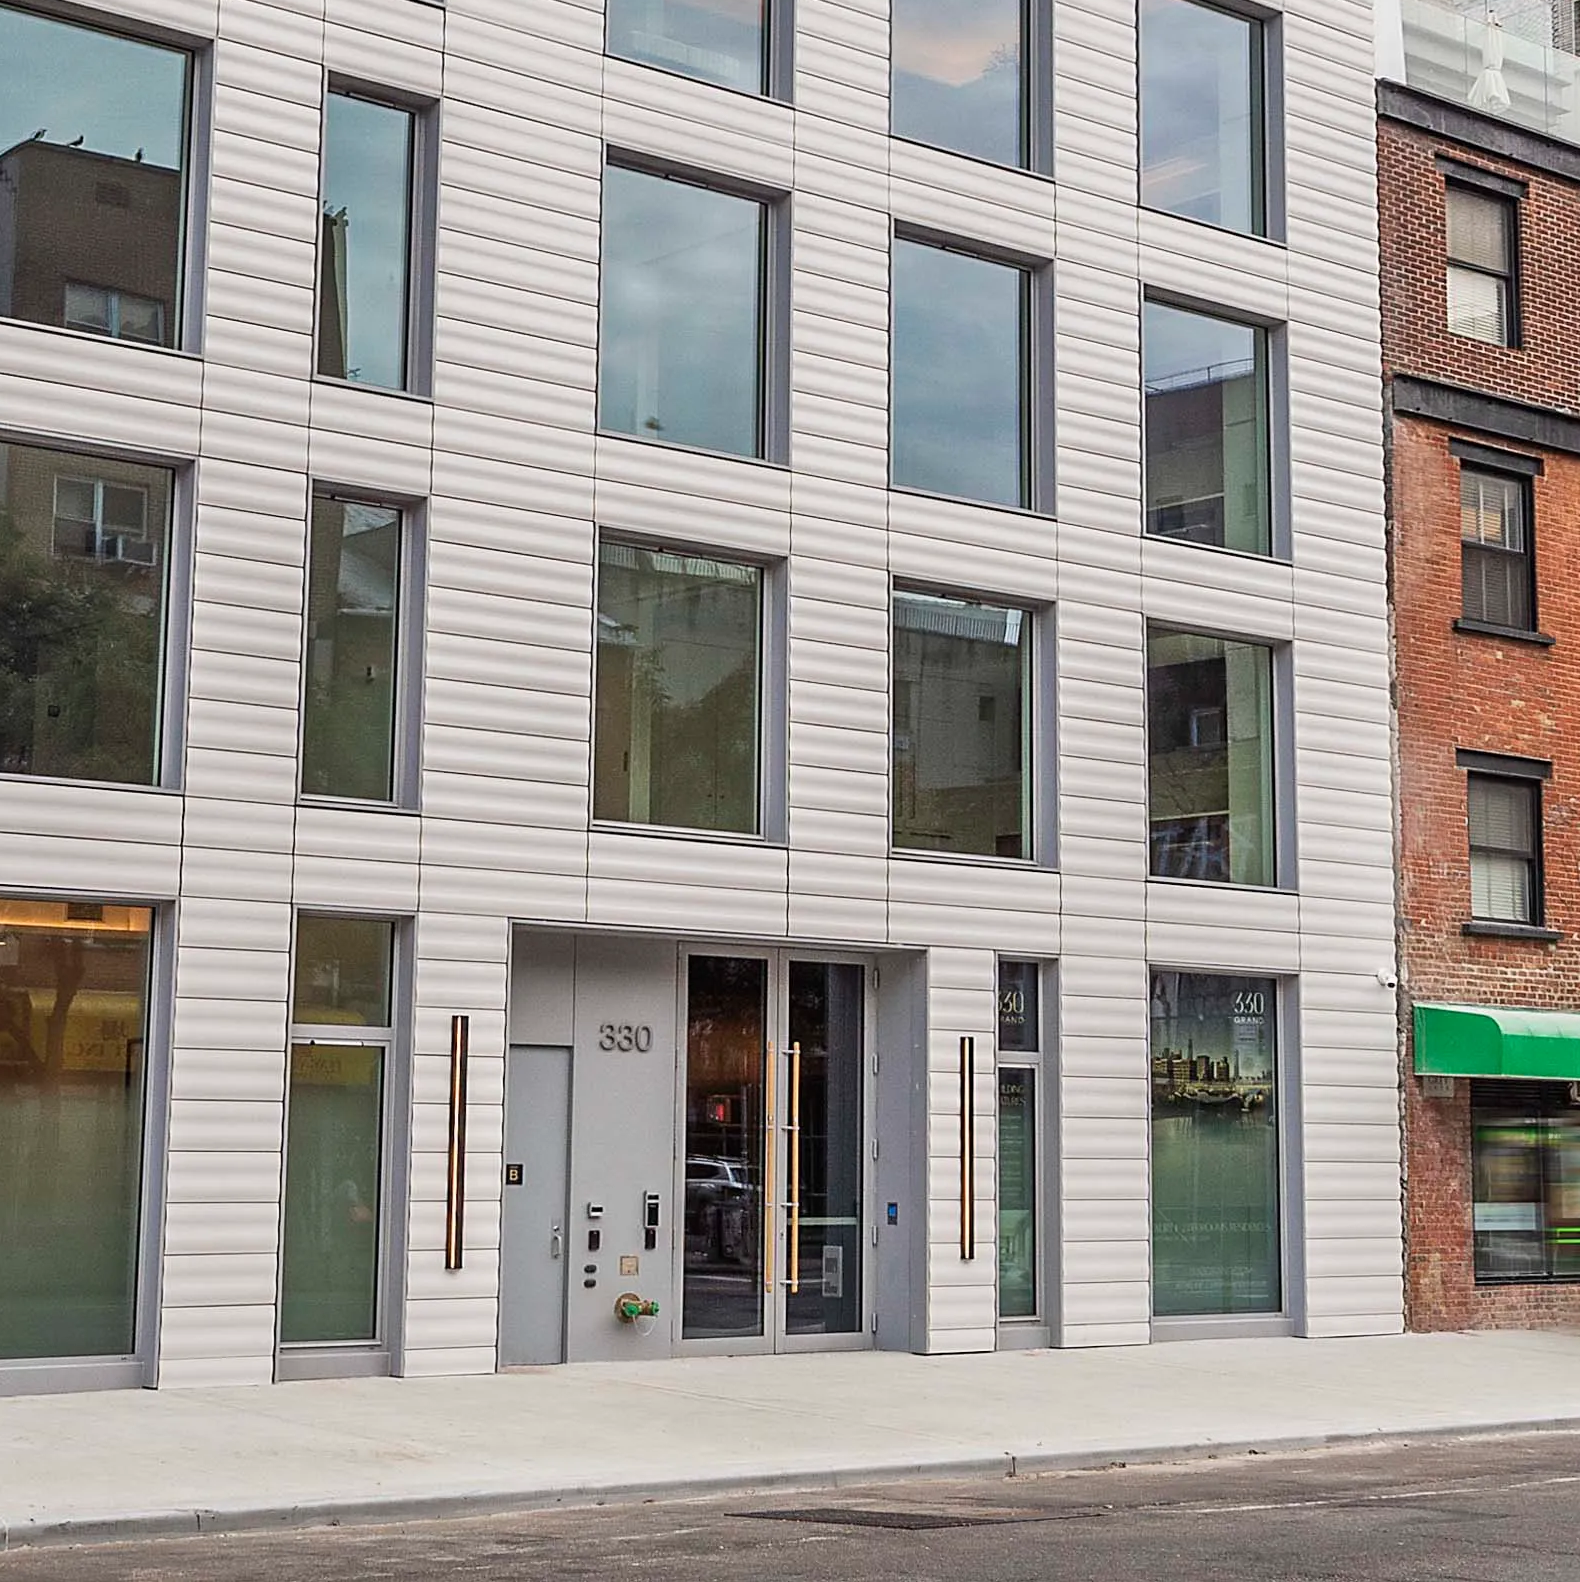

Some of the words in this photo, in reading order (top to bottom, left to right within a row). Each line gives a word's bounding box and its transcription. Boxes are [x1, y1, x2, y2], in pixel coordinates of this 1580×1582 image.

[1233, 1016, 1264, 1025] GRAND
[598, 1023, 653, 1053] 330
[509, 1169, 518, 1181] B
